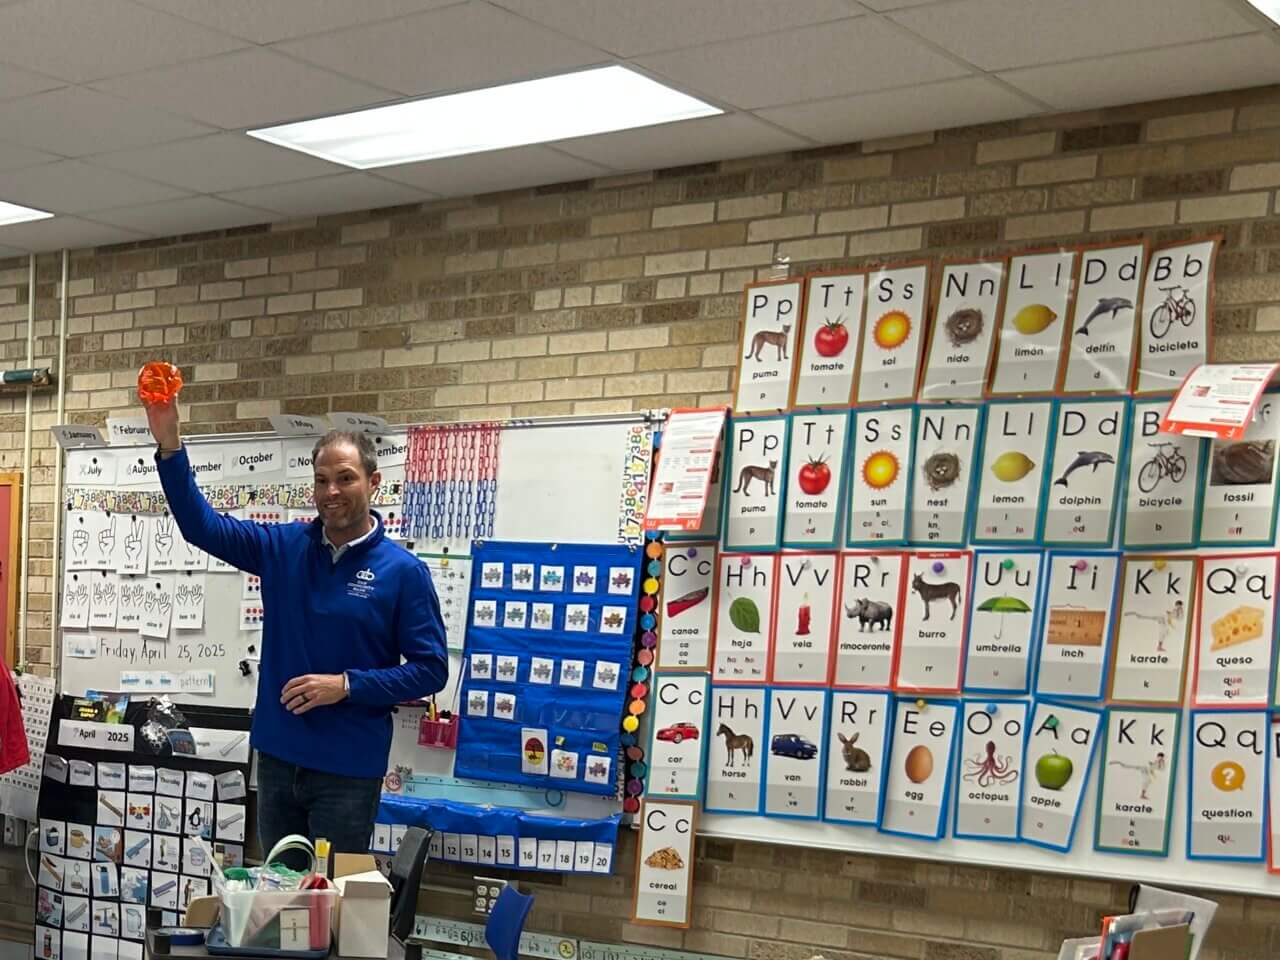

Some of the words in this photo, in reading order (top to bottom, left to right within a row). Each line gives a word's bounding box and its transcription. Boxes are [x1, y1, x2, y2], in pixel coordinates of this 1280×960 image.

[1148, 340, 1199, 353] bicicleta
[882, 357, 896, 366] sol
[946, 354, 970, 363] nido
[810, 362, 845, 371] tomate
[752, 369, 779, 380] puma
[120, 425, 150, 436] February
[377, 445, 407, 457] ember
[239, 453, 273, 466] October
[87, 466, 102, 477] July
[132, 463, 158, 476] Augus
[992, 494, 1025, 504] lemon
[1059, 494, 1101, 506] dolphin
[1138, 496, 1183, 508] bicycle
[1223, 492, 1254, 502] fossil
[795, 500, 828, 509] tomato
[870, 499, 887, 507] sun
[927, 499, 948, 507] nest
[741, 504, 766, 514] puma
[671, 627, 699, 635] canoa
[918, 630, 946, 639] burro
[731, 639, 752, 649] hoja
[792, 639, 813, 648] vela
[840, 641, 891, 652] rinoceronte
[975, 642, 1022, 653] umbrella
[100, 638, 138, 664] Friday,
[141, 639, 167, 664] April
[197, 643, 226, 658] 2025
[1061, 648, 1084, 658] inch
[1130, 654, 1169, 665] karate
[1216, 655, 1253, 667] queso
[79, 728, 96, 740] April
[107, 731, 129, 743] 2025
[722, 769, 746, 778] horse
[784, 774, 801, 782] van
[840, 777, 867, 788] rabbit
[904, 790, 924, 801] egg
[968, 791, 1009, 802] octopus
[1030, 794, 1061, 809] apple
[1115, 803, 1153, 814] karate
[1201, 807, 1253, 820] question
[430, 843, 438, 852] 11
[447, 846, 456, 855] 12
[464, 847, 474, 856] 13
[482, 849, 492, 858] 14
[501, 848, 511, 857] 15
[523, 851, 533, 860] 16
[541, 853, 552, 863] 17
[560, 854, 570, 864] 18
[579, 855, 589, 864] 19
[596, 857, 608, 867] 20
[648, 881, 677, 891] cereal
